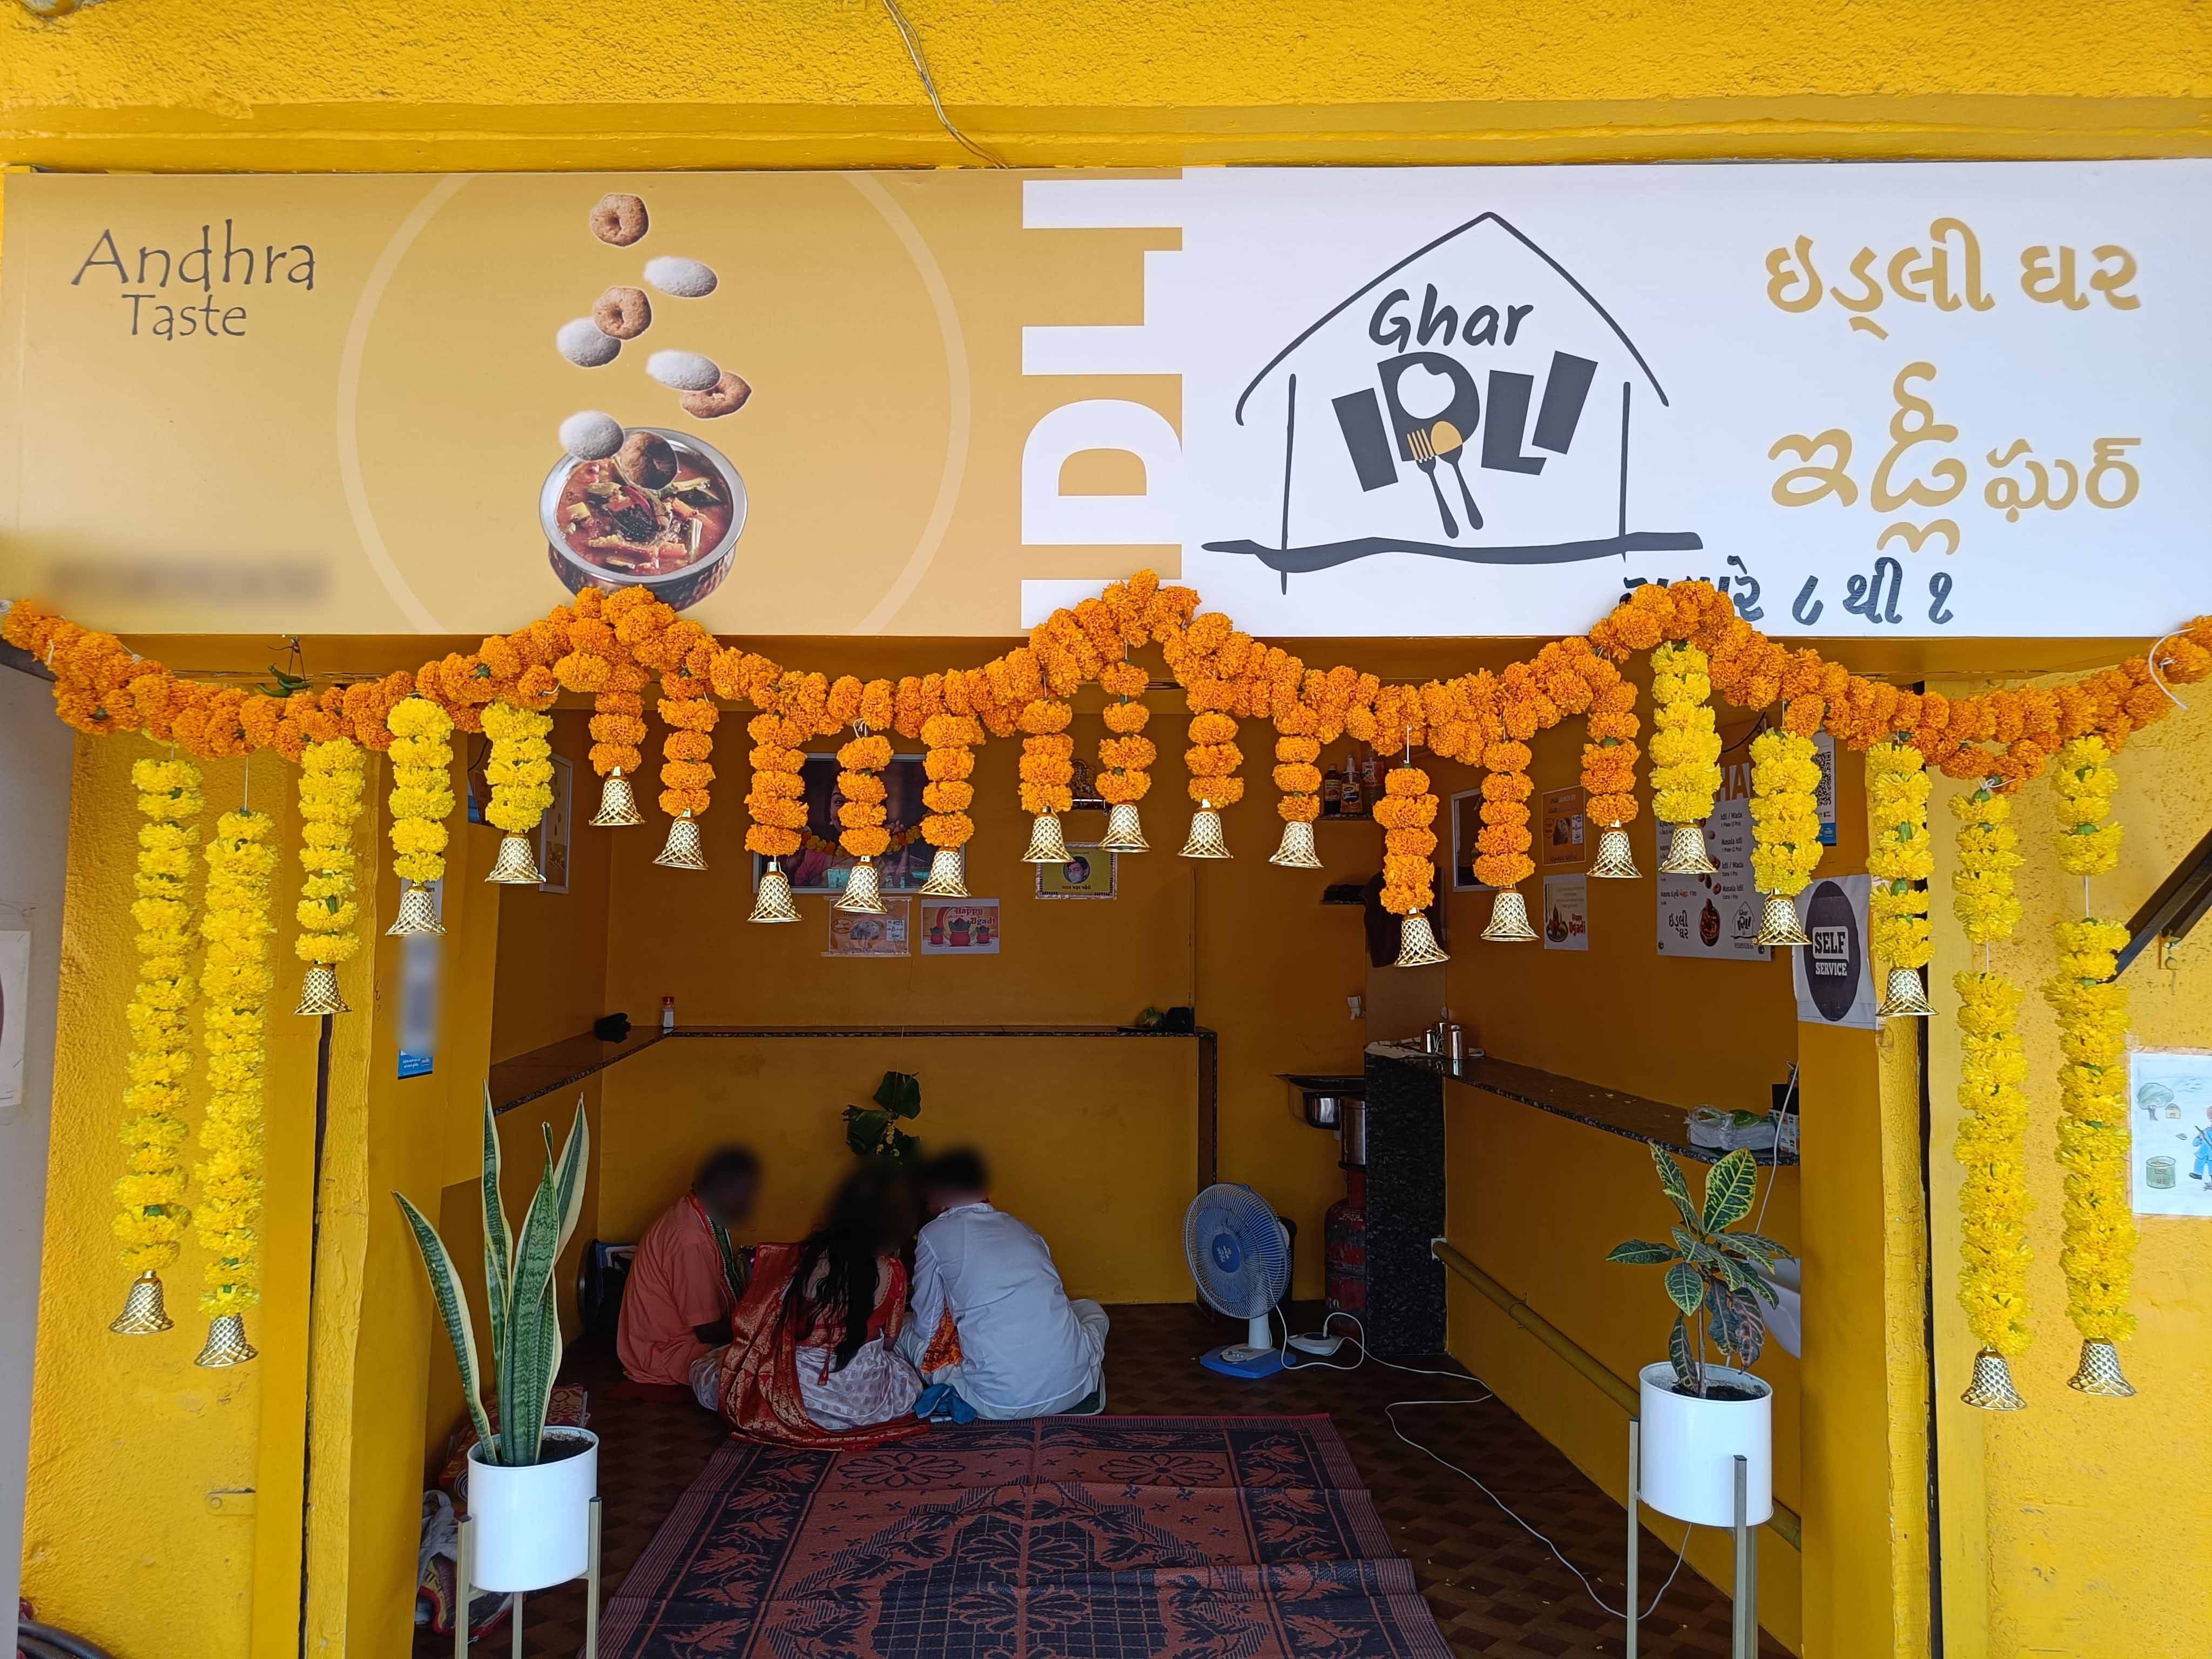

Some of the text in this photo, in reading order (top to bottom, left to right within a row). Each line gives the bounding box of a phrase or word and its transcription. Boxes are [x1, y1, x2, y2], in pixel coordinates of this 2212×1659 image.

[71, 219, 315, 292] Andhra
[1766, 218, 2141, 338] ઇડ્લી ઘર
[122, 294, 247, 341] Taste
[1369, 284, 1534, 353] Ghar
[1332, 350, 1598, 492] IDLI
[1984, 437, 2141, 523] ఘర్
[1843, 557, 1903, 624] થી
[954, 907, 983, 916] Happy
[1815, 932, 1845, 954] SELF
[1815, 962, 1847, 976] SERVICE
